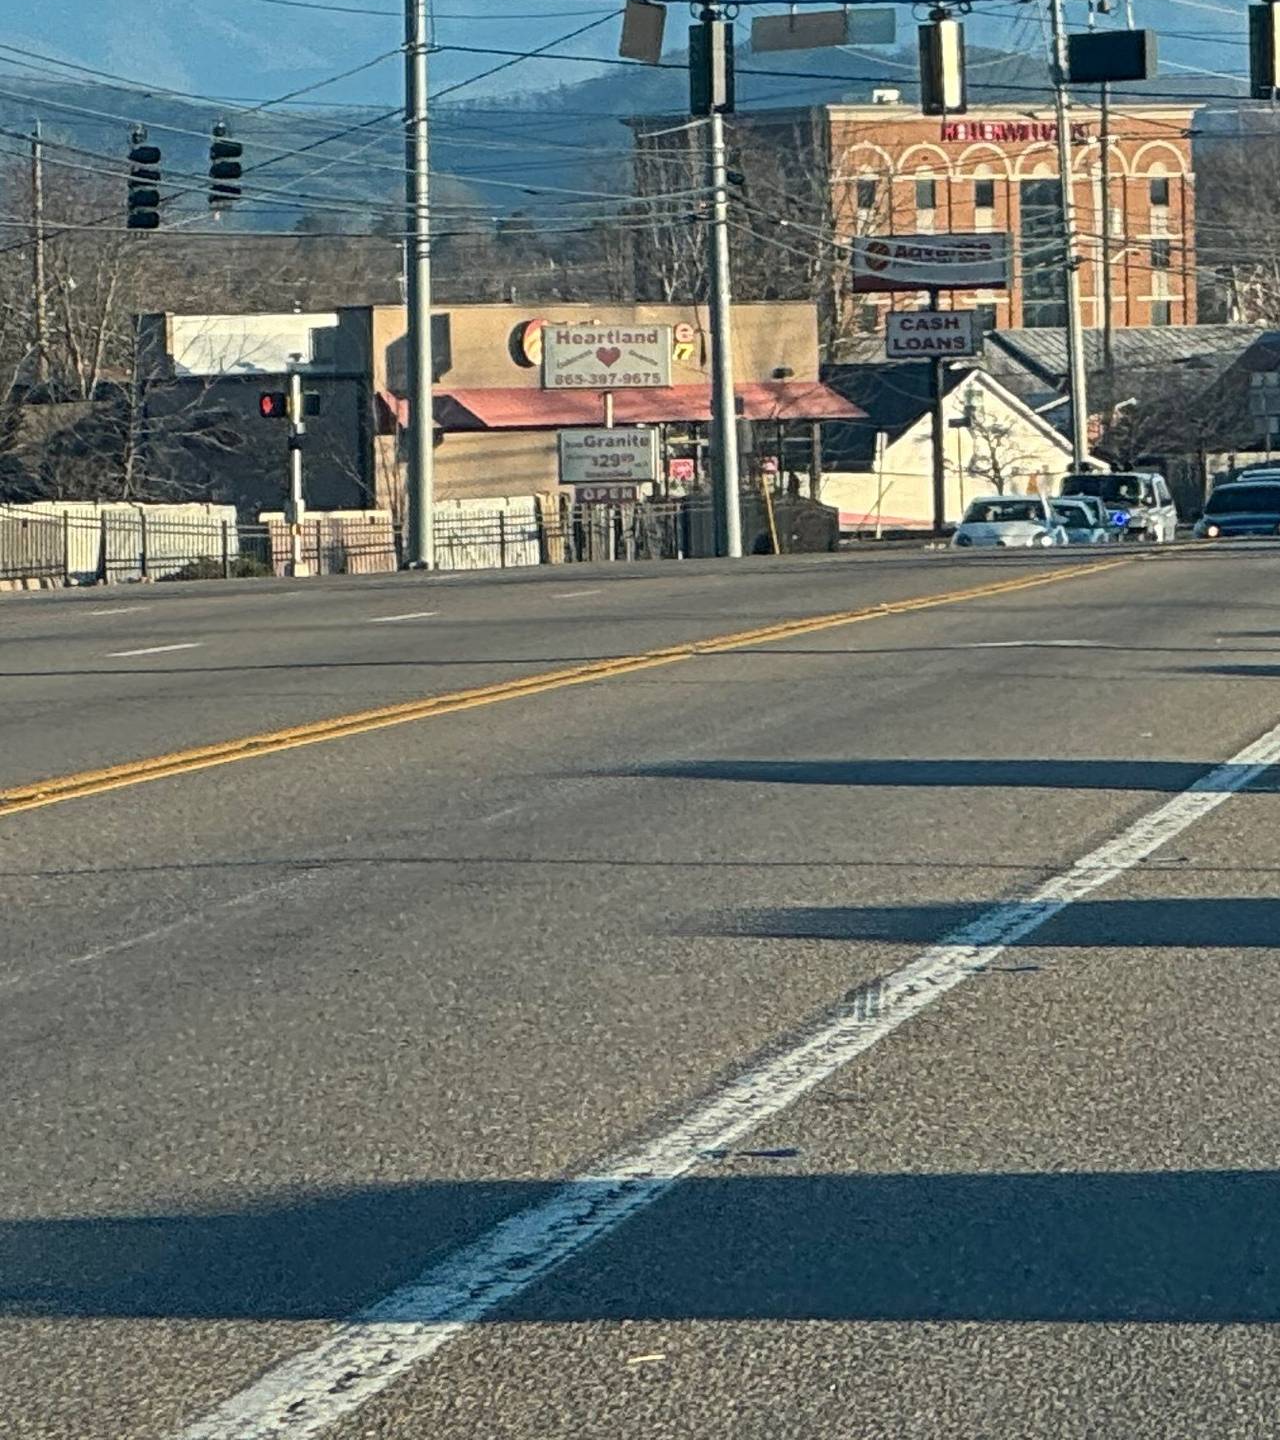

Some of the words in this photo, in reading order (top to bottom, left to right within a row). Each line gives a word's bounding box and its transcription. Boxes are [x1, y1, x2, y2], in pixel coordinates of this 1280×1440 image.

[900, 317, 960, 331] CASH
[556, 330, 659, 345] Heartland
[893, 336, 966, 350] LOANS
[584, 434, 649, 448] Granite
[583, 487, 633, 501] OPEN
